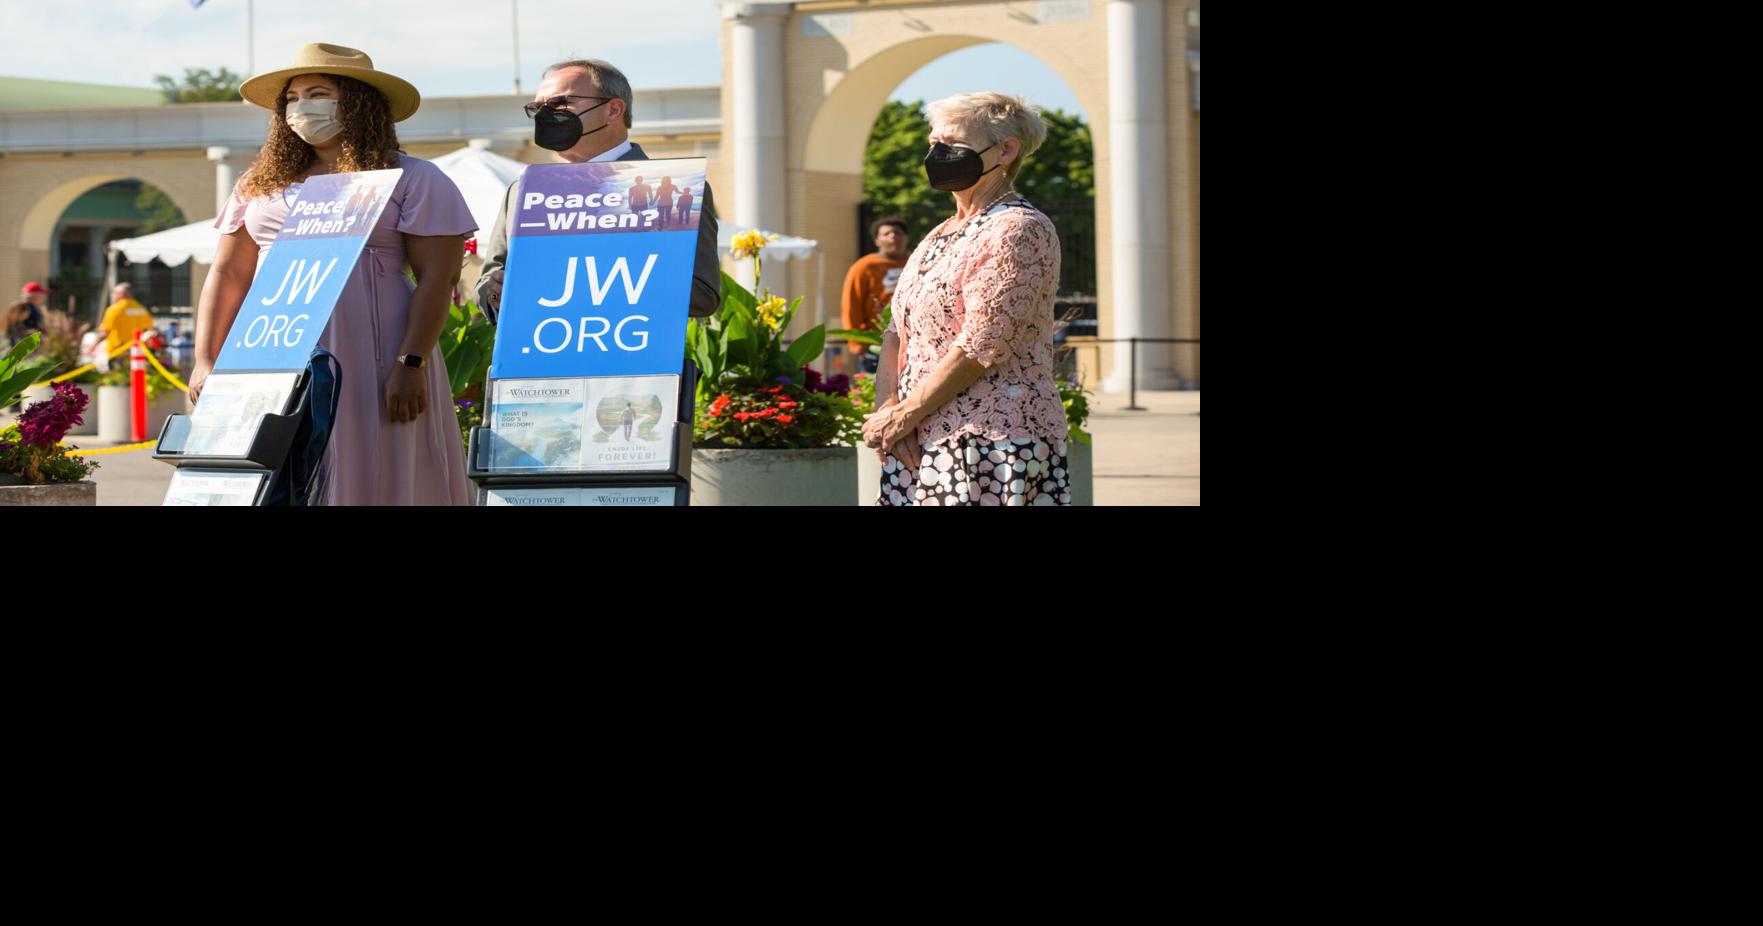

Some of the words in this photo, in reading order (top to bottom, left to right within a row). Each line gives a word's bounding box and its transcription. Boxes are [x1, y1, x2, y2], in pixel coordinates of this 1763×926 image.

[291, 200, 346, 217] Peace
[523, 191, 622, 210] Peace
[261, 257, 338, 306] JW
[537, 253, 659, 308] JW
[236, 313, 310, 348] .ORG
[521, 314, 650, 354] .ORG
[509, 388, 571, 398] WATCHTOWER
[598, 452, 656, 461] FOREVER!
[504, 496, 565, 505] WATCHTOWER
[598, 495, 660, 504] WATCHTOWER
